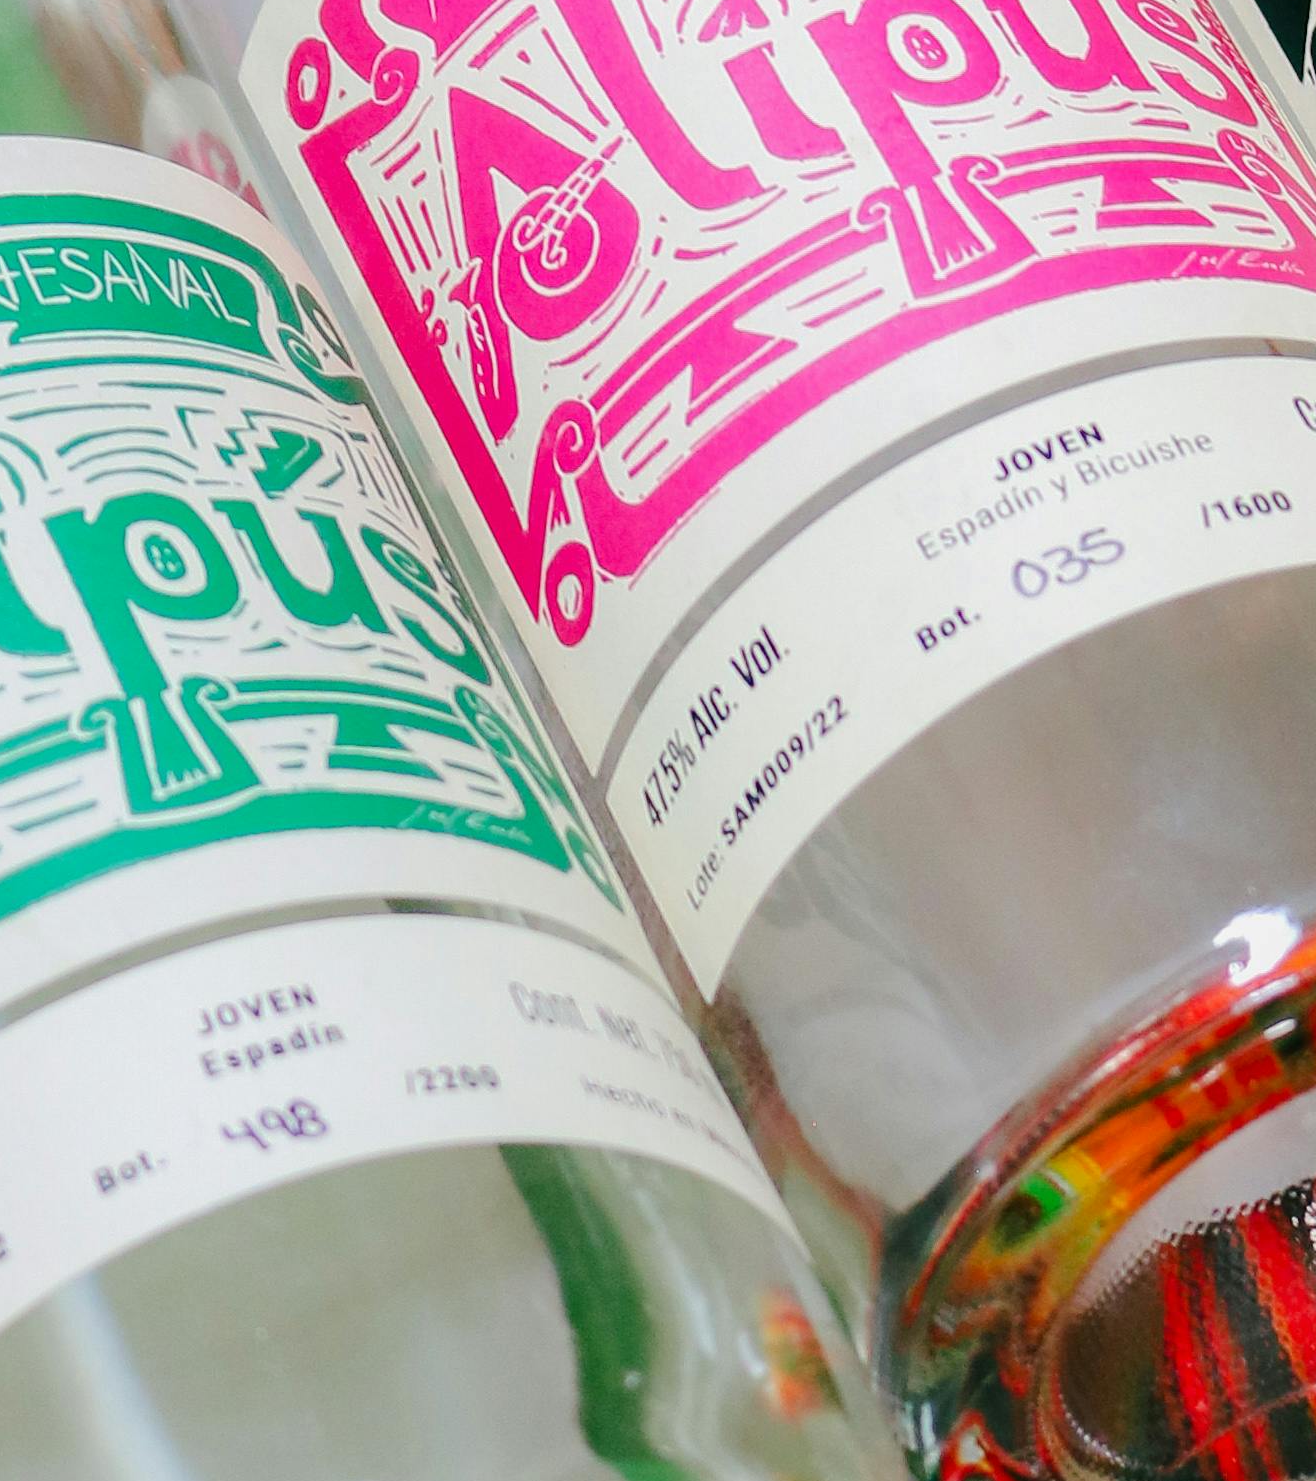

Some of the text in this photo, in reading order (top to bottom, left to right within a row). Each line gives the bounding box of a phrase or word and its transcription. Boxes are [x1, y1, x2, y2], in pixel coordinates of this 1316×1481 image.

[994, 421, 1107, 483] JOVEN
[915, 432, 1215, 562] Espadín y Bicuishe
[914, 489, 1294, 652] Bot. /1600
[1011, 526, 1127, 599] 035
[641, 623, 791, 828] 47.5% Alc. Vol.
[685, 694, 850, 912] Lote: SAM009/22
[197, 983, 319, 1037] JOVEN
[219, 1097, 329, 1151] 498
[94, 1149, 171, 1196] Bot.
